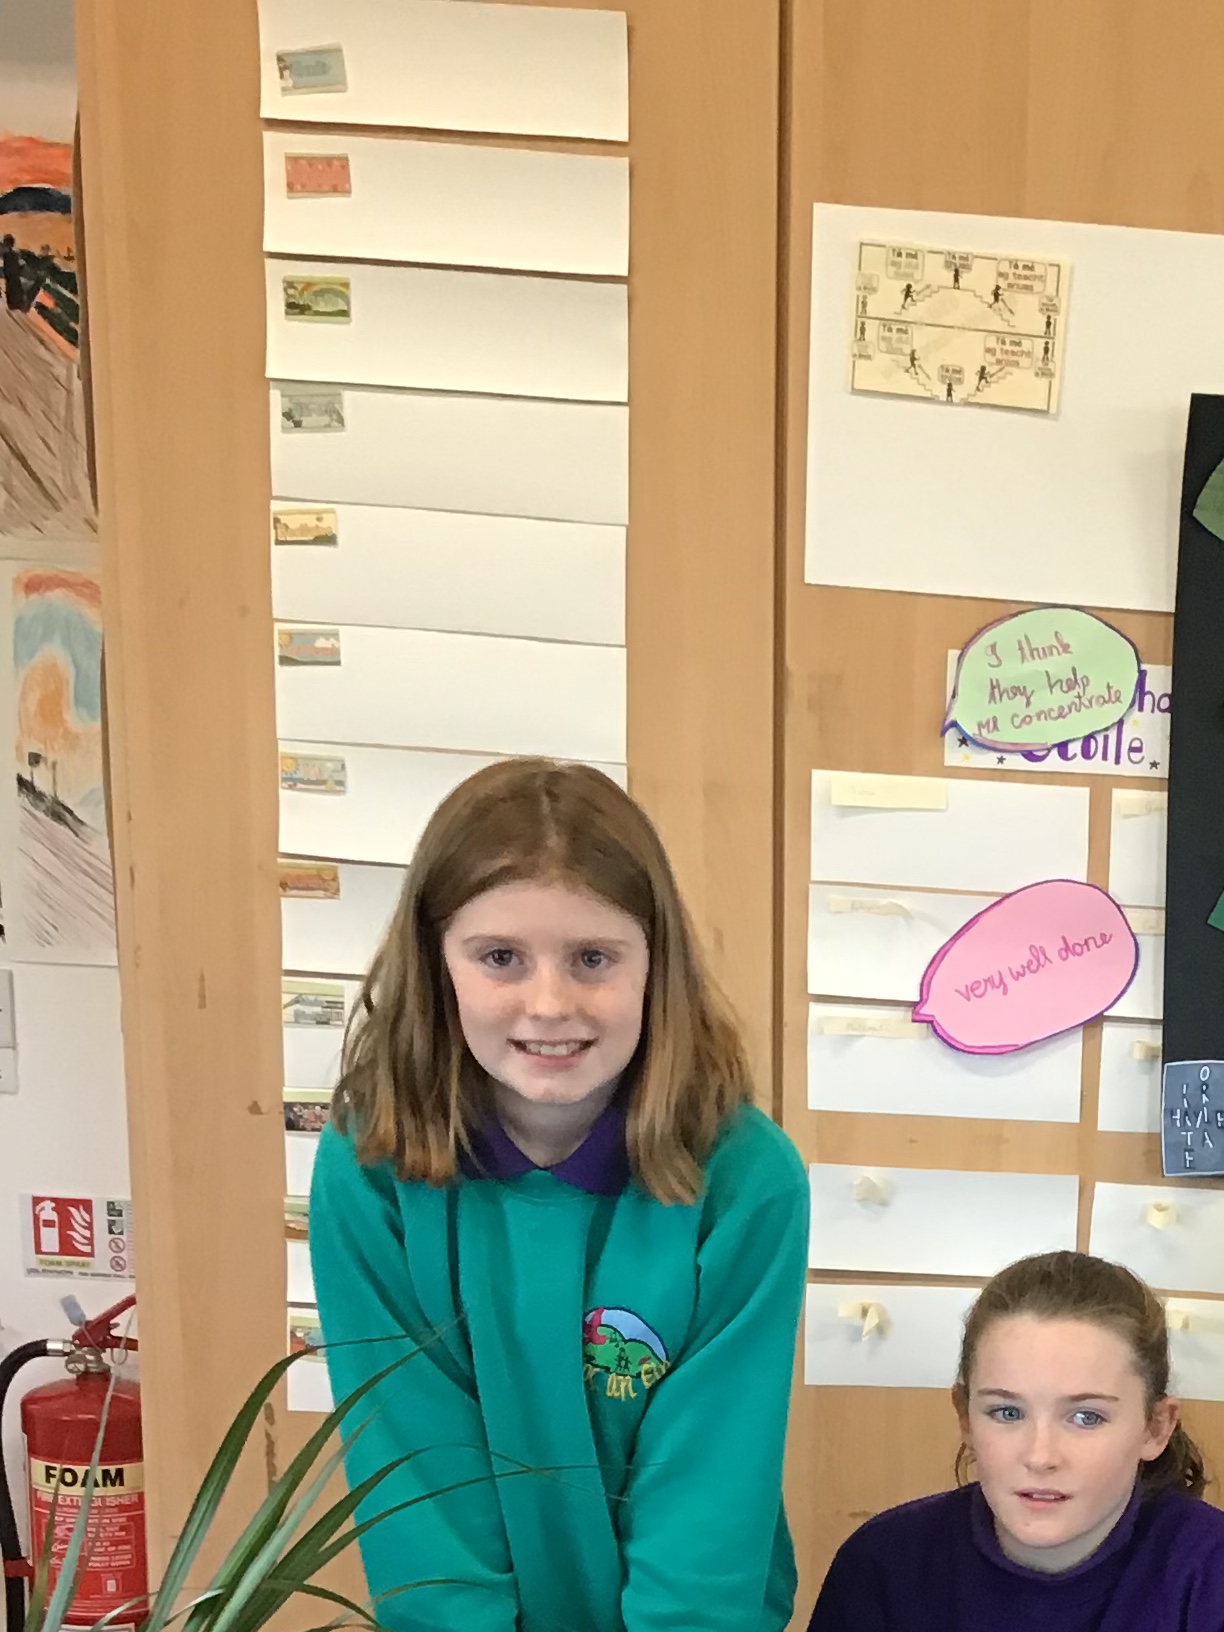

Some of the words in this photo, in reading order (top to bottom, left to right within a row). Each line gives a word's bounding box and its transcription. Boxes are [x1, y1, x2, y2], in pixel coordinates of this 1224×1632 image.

[1045, 666, 1090, 695] help
[1010, 681, 1124, 730] concentrate
[954, 970, 1010, 1003] very
[1007, 943, 1054, 983] well
[1057, 929, 1114, 963] done
[44, 1464, 125, 1488] FOAM
